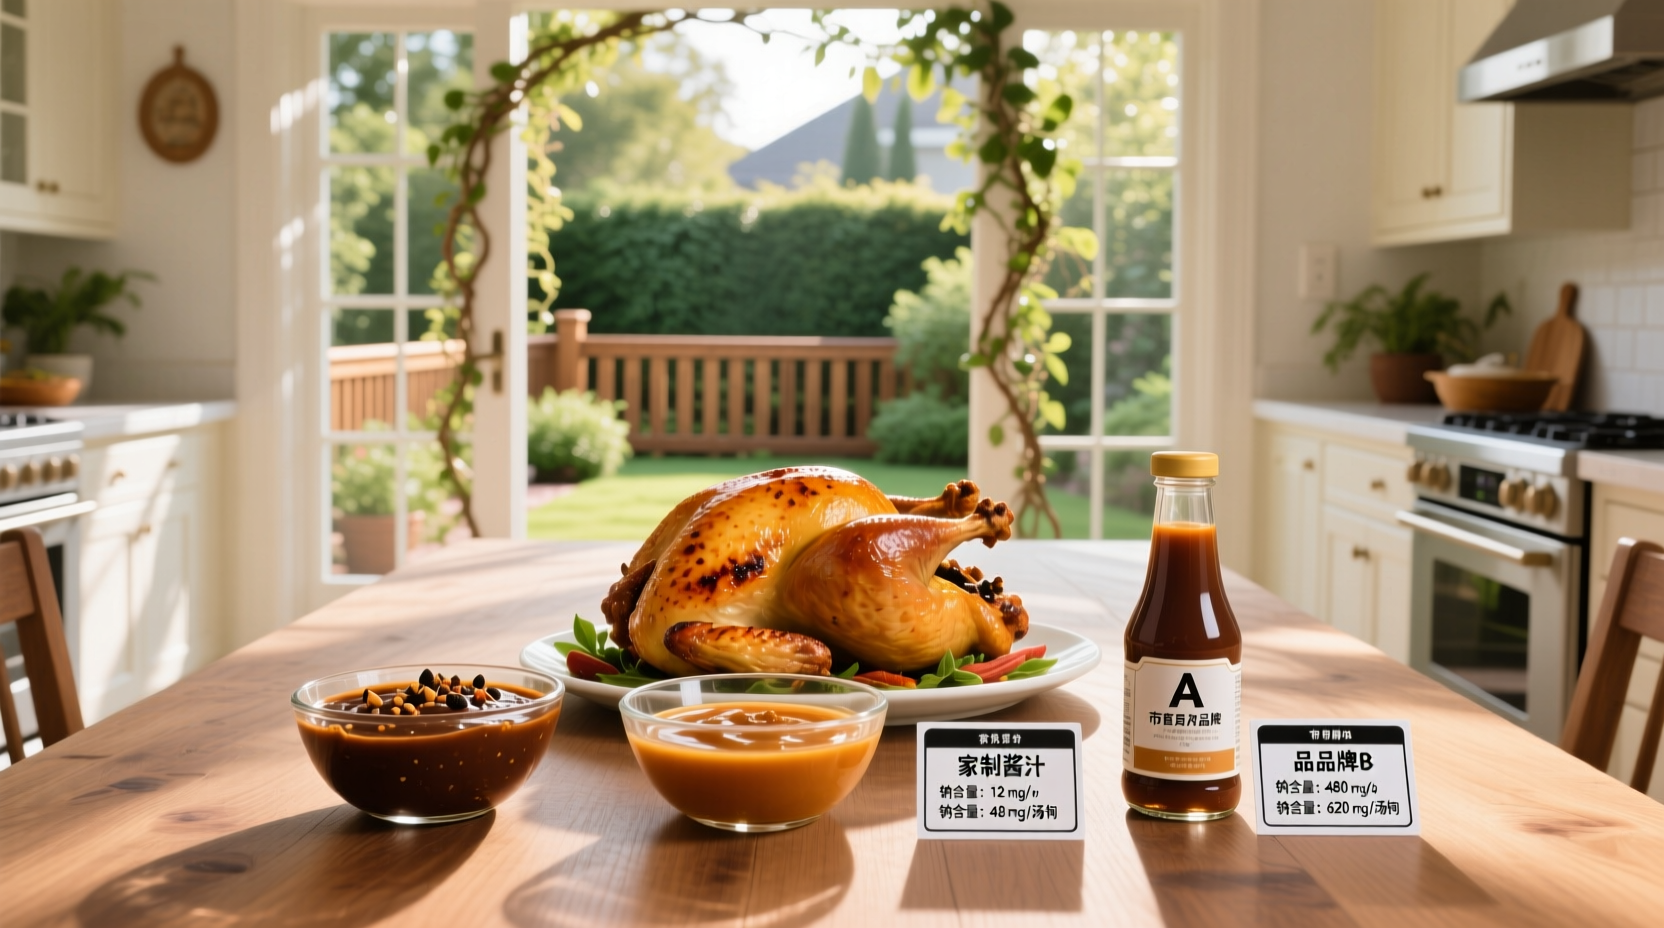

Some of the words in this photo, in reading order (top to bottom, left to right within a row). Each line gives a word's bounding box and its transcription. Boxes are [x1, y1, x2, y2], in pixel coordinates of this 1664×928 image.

[1169, 673, 1204, 708] A
[958, 753, 1045, 778] 家制酱汁
[1294, 750, 1374, 772] 品品牌B
[990, 785, 1005, 798] 12
[1324, 781, 1348, 794] 480
[989, 805, 1006, 818] 48
[1327, 801, 1349, 814] 620
